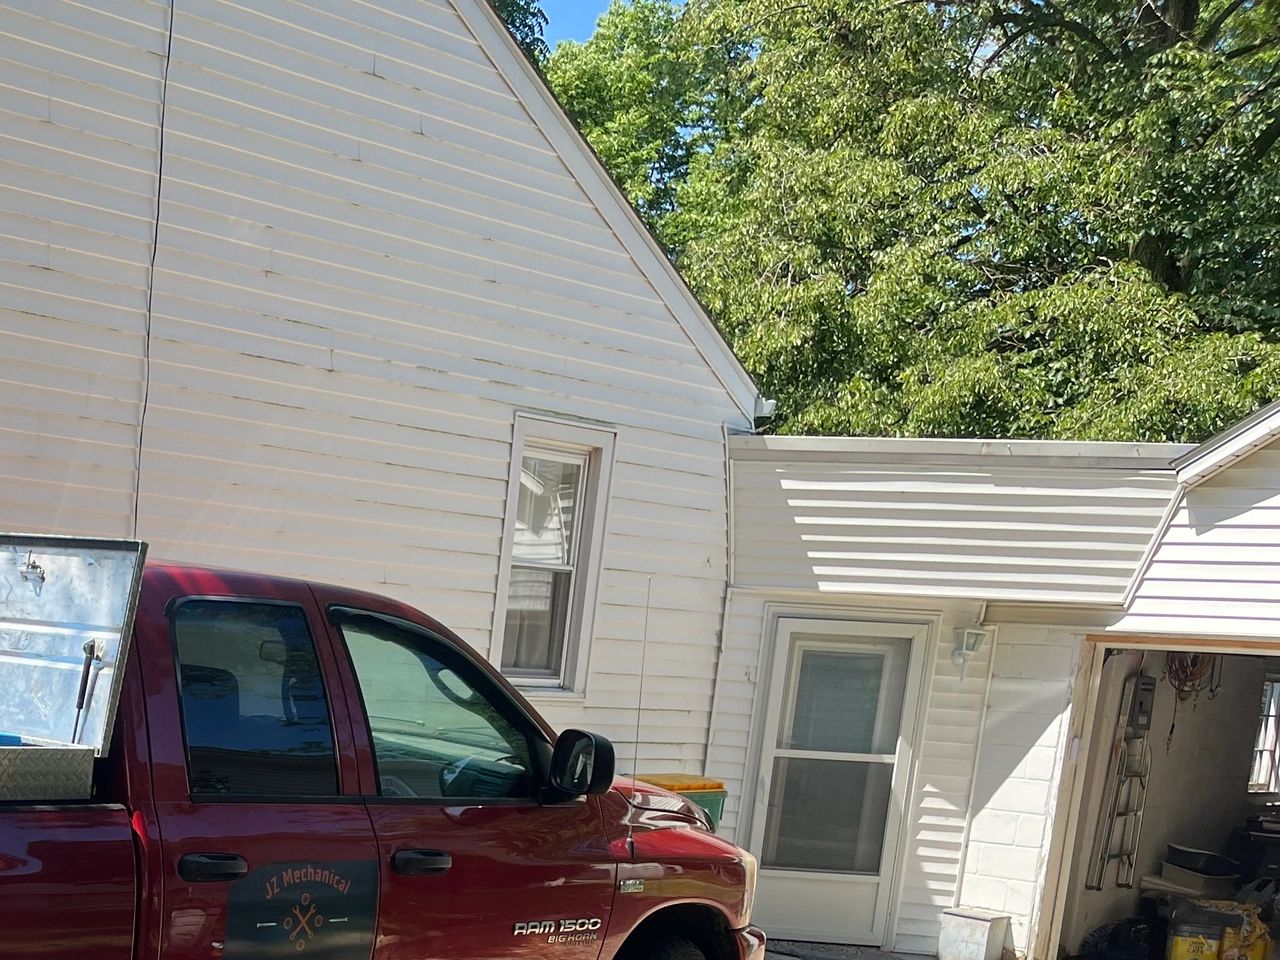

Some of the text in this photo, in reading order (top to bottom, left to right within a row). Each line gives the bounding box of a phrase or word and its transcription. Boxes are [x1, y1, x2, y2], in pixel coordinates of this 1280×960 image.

[265, 864, 351, 899] JZ Mechanical
[513, 918, 602, 936] RAM 1500
[547, 935, 566, 944] BIG
[567, 932, 598, 942] HORN
